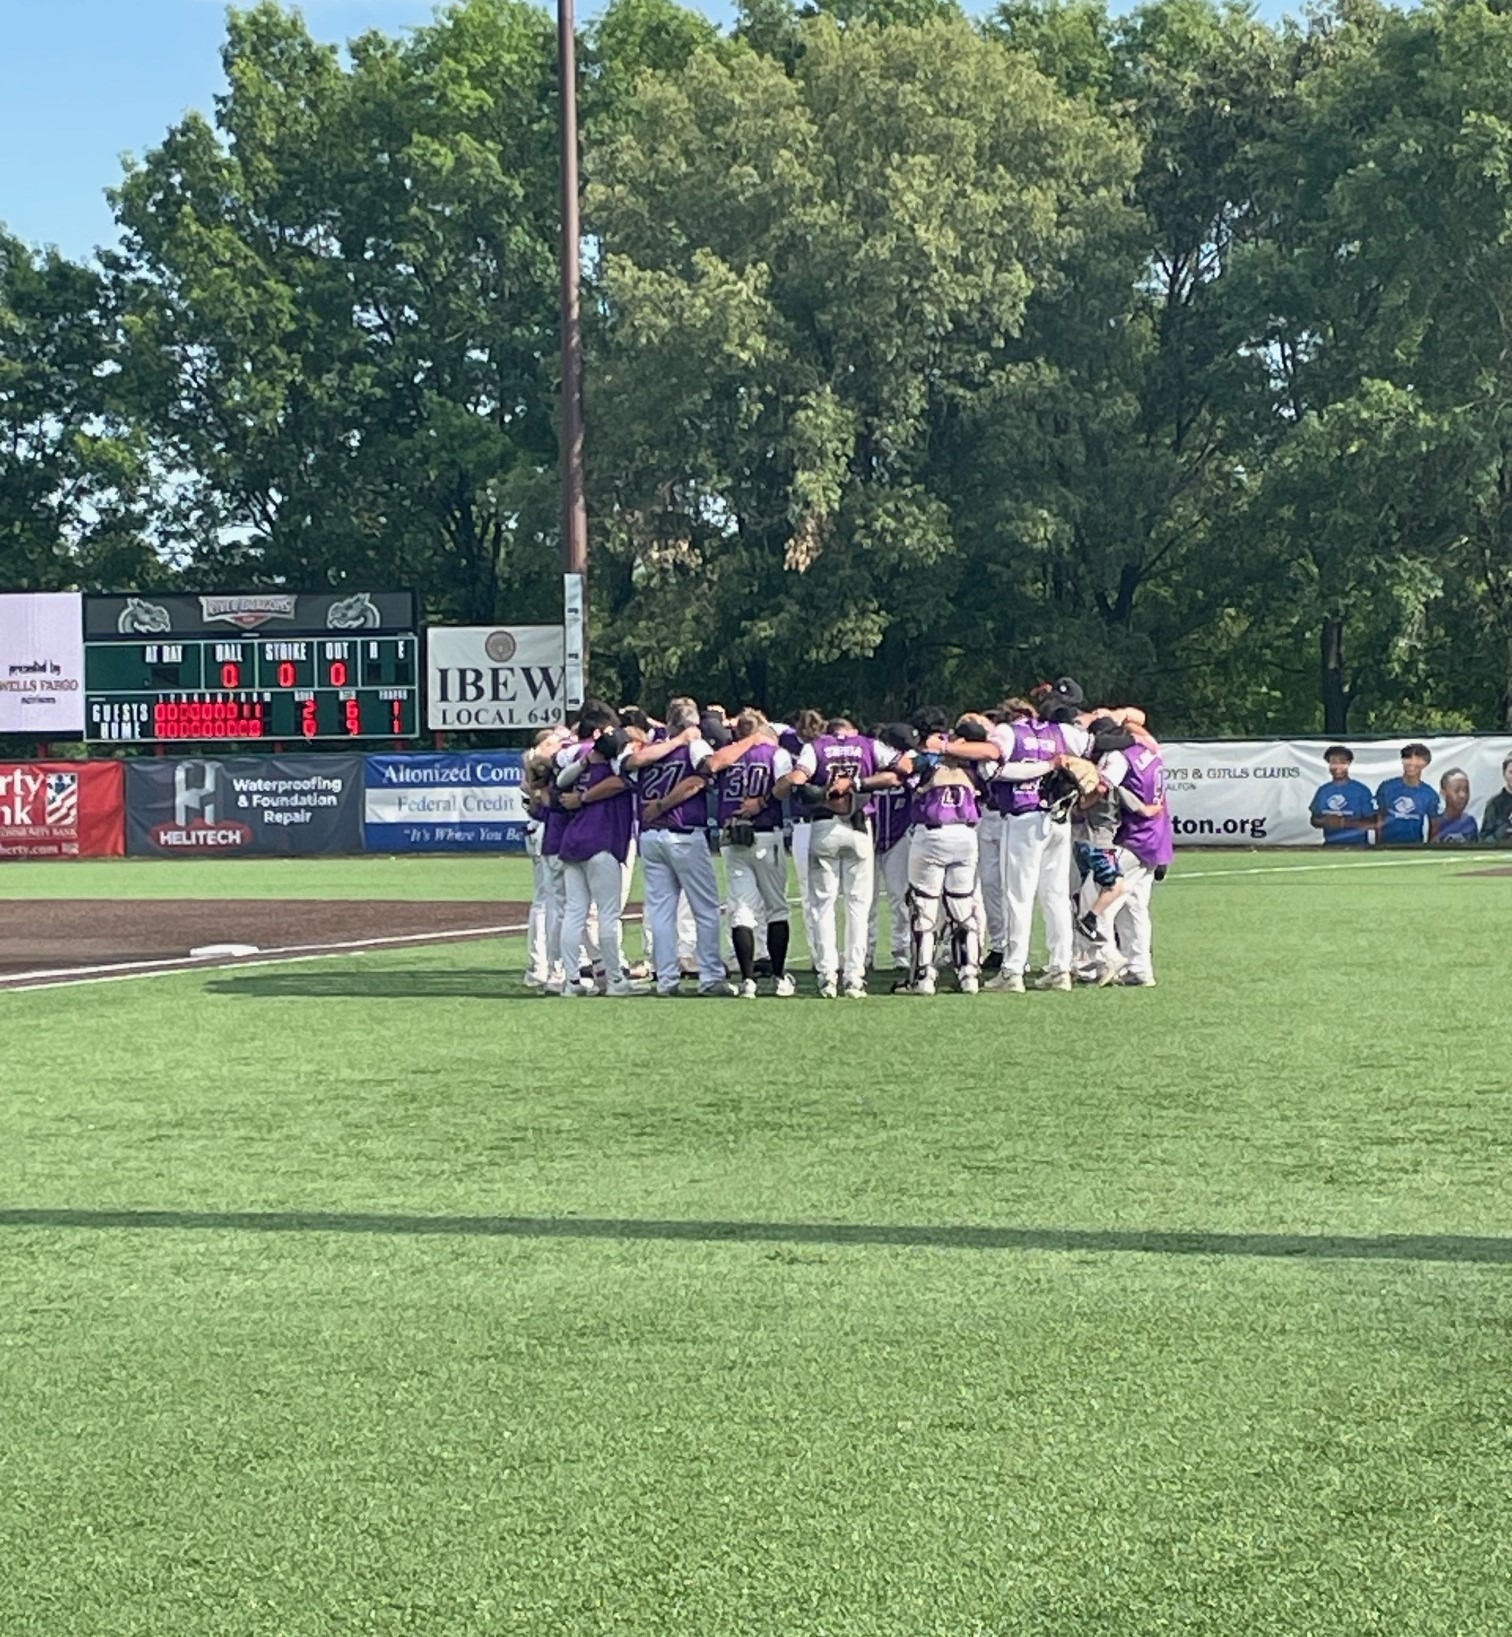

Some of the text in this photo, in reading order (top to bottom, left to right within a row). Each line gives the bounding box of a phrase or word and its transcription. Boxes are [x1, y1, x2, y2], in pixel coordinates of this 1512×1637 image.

[215, 643, 243, 662] BALL
[265, 642, 307, 661] STRIKE
[325, 642, 349, 660] OUT
[221, 662, 239, 689] 0
[278, 662, 296, 688] 0
[330, 662, 347, 688] 0
[40, 679, 79, 691] FARGO
[436, 666, 565, 703] IBEW
[92, 703, 148, 722] GUESTS
[441, 707, 562, 725] LOCAL 649
[101, 721, 141, 739] HOME
[383, 763, 524, 784] Altonized Com
[641, 760, 687, 803] 27
[1192, 768, 1203, 779] &
[1206, 768, 1250, 779] GIRLS
[1253, 767, 1300, 779] CLUBS
[0, 769, 45, 801] rty
[233, 776, 342, 793] Waterproofing
[237, 792, 338, 808] & Foundation
[397, 795, 514, 813] Federal Credit
[264, 810, 312, 826] Repair
[434, 828, 475, 841] Where
[479, 828, 502, 841] You
[1171, 816, 1267, 839] ton.org
[160, 830, 241, 846] HELITECH
